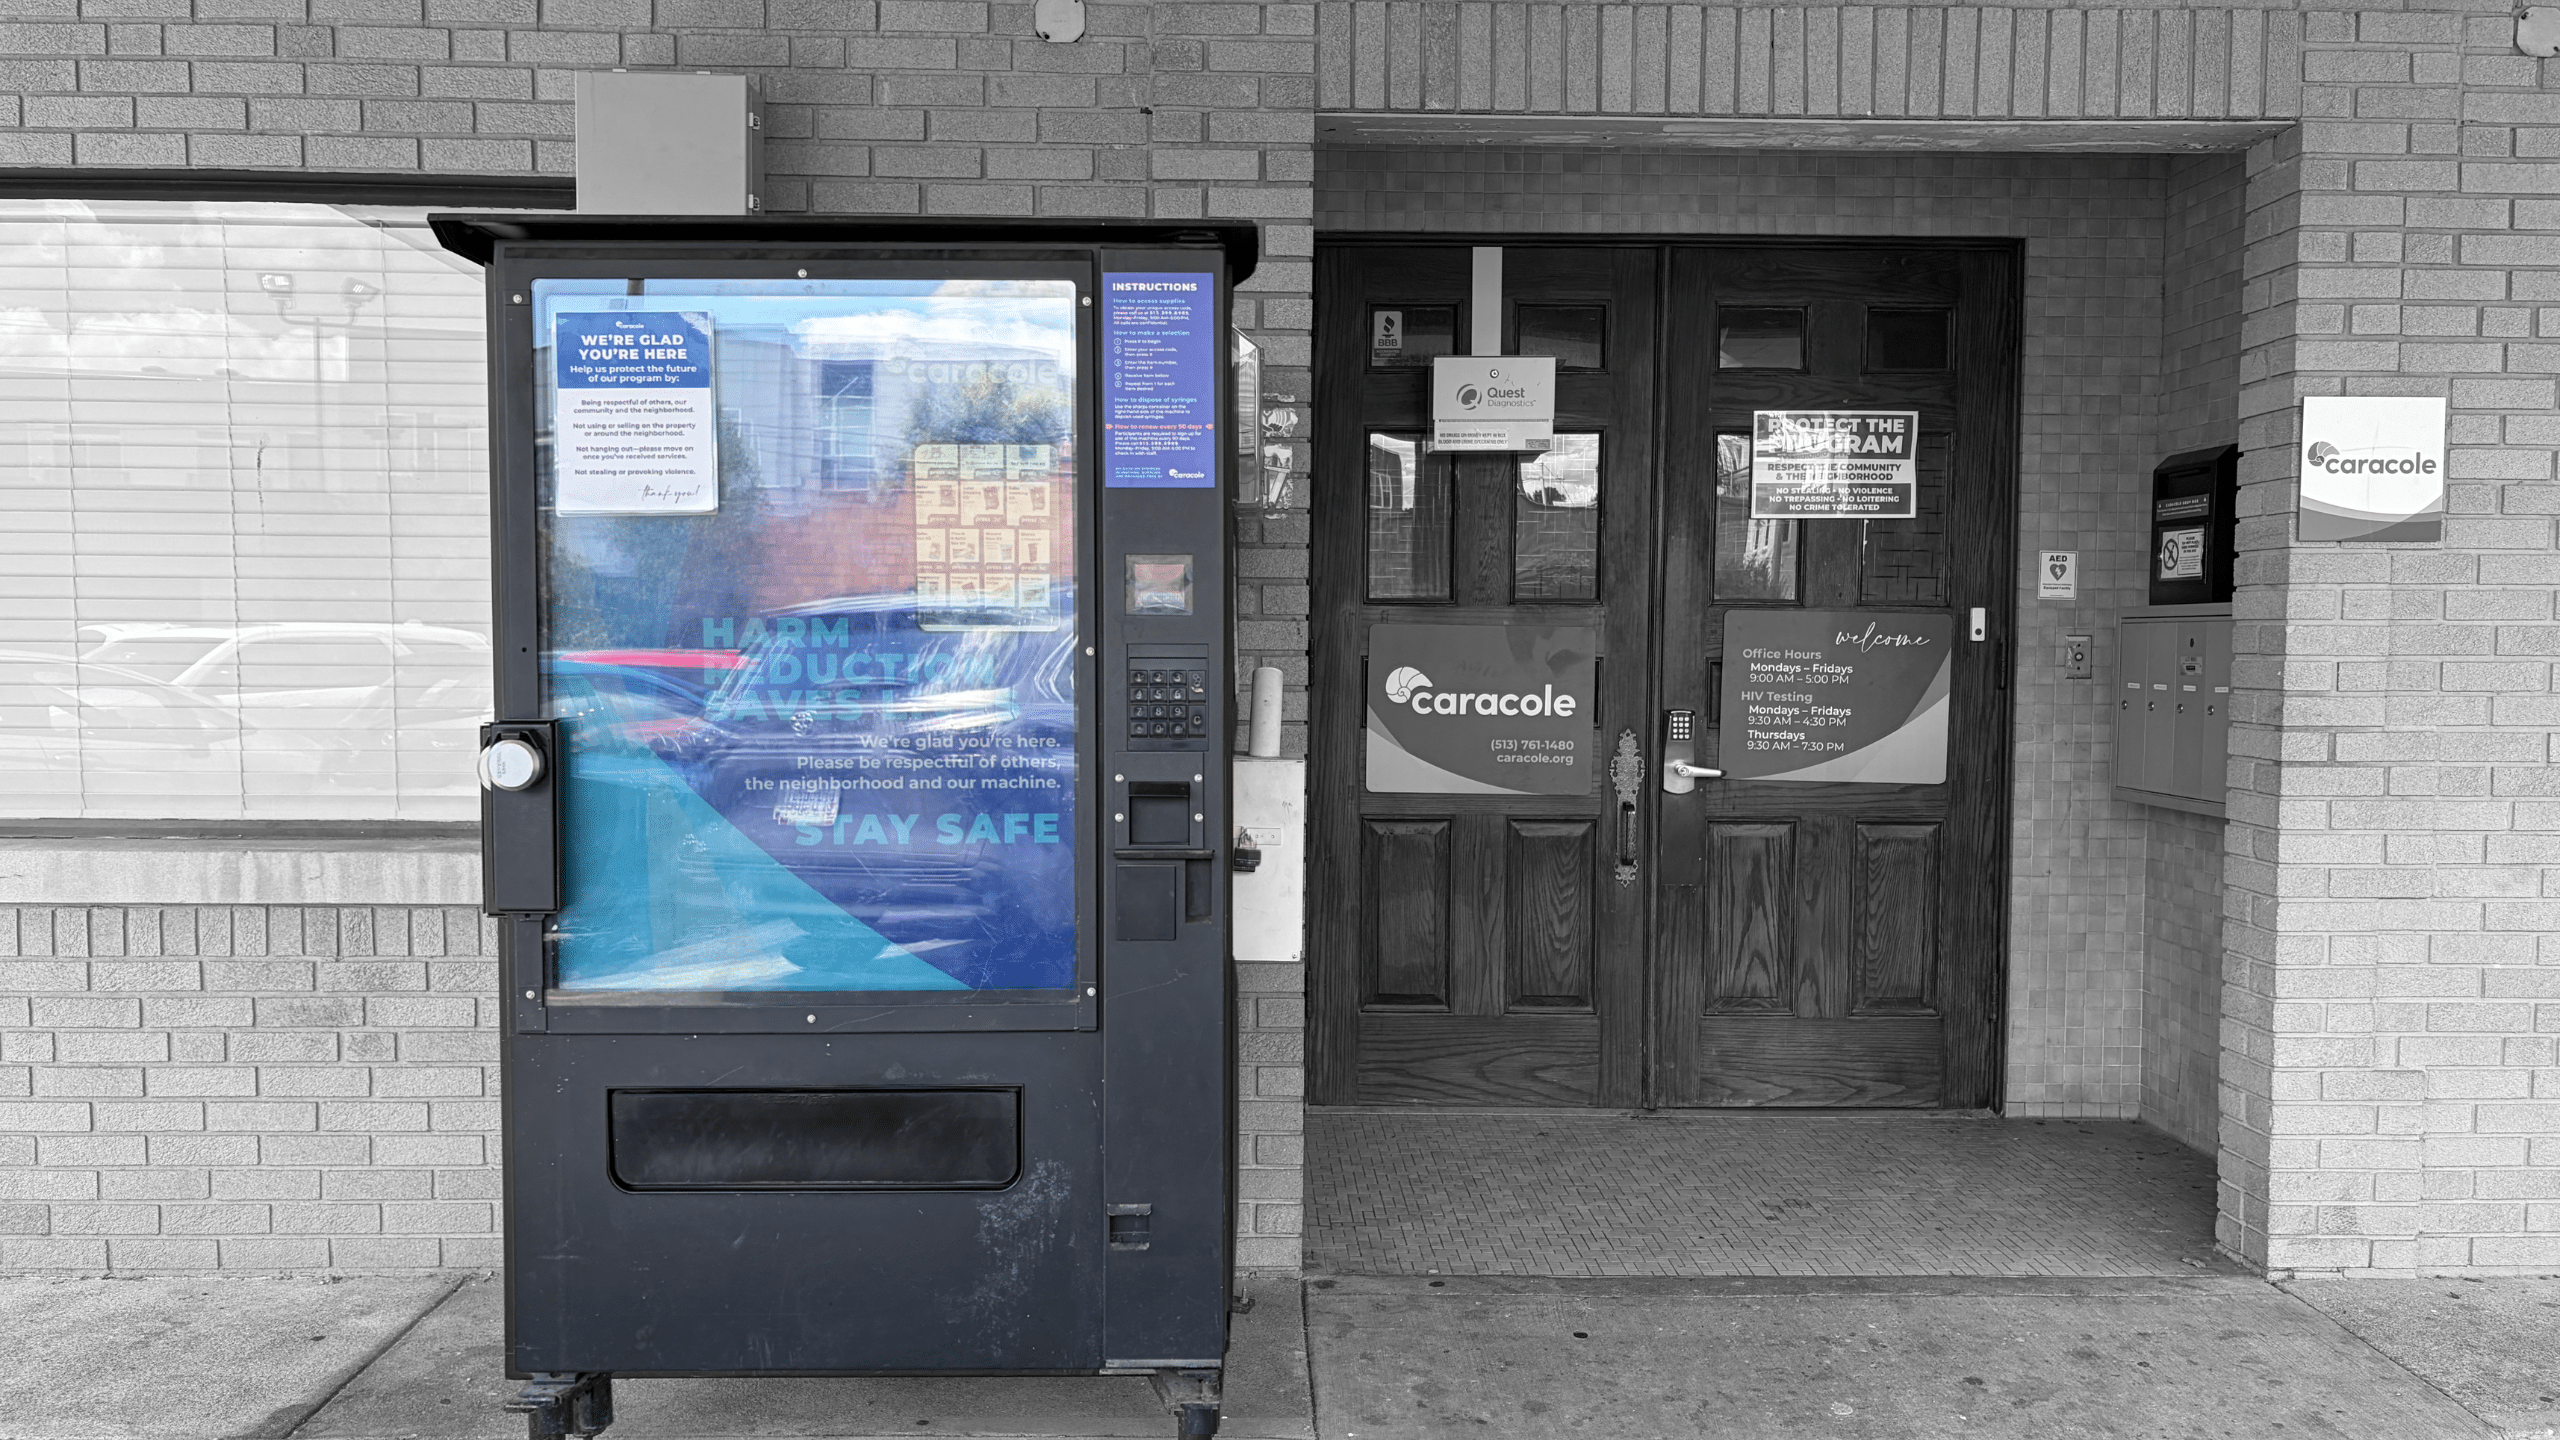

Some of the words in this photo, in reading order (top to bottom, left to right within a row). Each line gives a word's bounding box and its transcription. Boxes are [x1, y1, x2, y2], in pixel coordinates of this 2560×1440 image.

[1113, 283, 1197, 291] INSTRUCTIONS
[581, 334, 634, 346] WE’RE
[639, 334, 684, 345] GLAD
[1378, 339, 1398, 347] BBB
[579, 348, 639, 360] YOU’RE
[644, 348, 687, 359] HERE
[570, 365, 593, 375] Help
[609, 366, 645, 375] protect
[647, 365, 664, 373] the
[666, 364, 697, 372] future
[907, 359, 1059, 384] caracole
[588, 374, 599, 383] of
[619, 376, 662, 384] program
[665, 374, 680, 384] by:
[1487, 387, 1525, 398] Quest
[573, 407, 614, 415] community
[617, 422, 640, 430] selling
[1768, 417, 1861, 433] PROTECT
[1866, 419, 1904, 432] THE
[1767, 434, 1903, 455] PGRAM
[601, 453, 625, 461] you’ve
[2325, 451, 2437, 474] caracole
[1768, 463, 1814, 471] RESPECT
[1839, 463, 1901, 472] COMMUNITY
[1808, 473, 1893, 481] GHBORHOOD
[642, 484, 672, 501] thank
[674, 485, 700, 504] you!
[1791, 487, 1831, 495] STEALING
[1853, 487, 1893, 495] VIOLENCE
[1832, 503, 1880, 512] TOLERATED
[702, 617, 849, 648] HARM
[1835, 622, 1930, 653] welcome
[1743, 648, 1781, 659] Office
[1785, 649, 1822, 660] Hours
[703, 653, 995, 685] REDUCTION
[1751, 663, 1801, 675] Mondays
[1813, 663, 1853, 675] Fridays
[1749, 673, 1774, 683] 9:00
[1776, 673, 1794, 683] AM
[1805, 674, 1828, 684] 5:00
[1832, 673, 1849, 684] PM
[1410, 683, 1576, 717] caracole
[1741, 691, 1764, 701] HIV
[1766, 691, 1813, 704] Testing
[703, 689, 862, 722] SAVES
[1749, 705, 1800, 717] Mondays
[1811, 706, 1851, 717] Fridays
[1748, 715, 1771, 725] 9:30
[1773, 715, 1791, 725] AM
[1802, 717, 1826, 726] 4:30
[1829, 715, 1846, 726] PM
[858, 734, 911, 750] We're
[915, 734, 955, 750] glad
[958, 734, 1014, 750] you're
[1017, 734, 1060, 748] here.
[1747, 730, 1805, 742] Thursdays
[1491, 739, 1518, 752] (513)
[1521, 740, 1574, 750] 761-1480
[1747, 740, 1770, 750] 9:30
[1772, 741, 1790, 750] AM
[1801, 742, 1824, 751] 7:30
[1827, 742, 1844, 751] PM
[797, 757, 853, 769] Please
[859, 757, 881, 769] be
[886, 756, 974, 772] respectful
[979, 756, 996, 769] of
[1001, 756, 1061, 770] others,
[1497, 753, 1574, 766] caracole.org
[745, 777, 774, 790] the
[779, 775, 906, 792] neighborhood
[909, 776, 942, 791] and
[947, 779, 976, 789] our
[981, 775, 1061, 789] machine.
[796, 813, 920, 846] STAY
[936, 812, 1059, 845] SAFE
